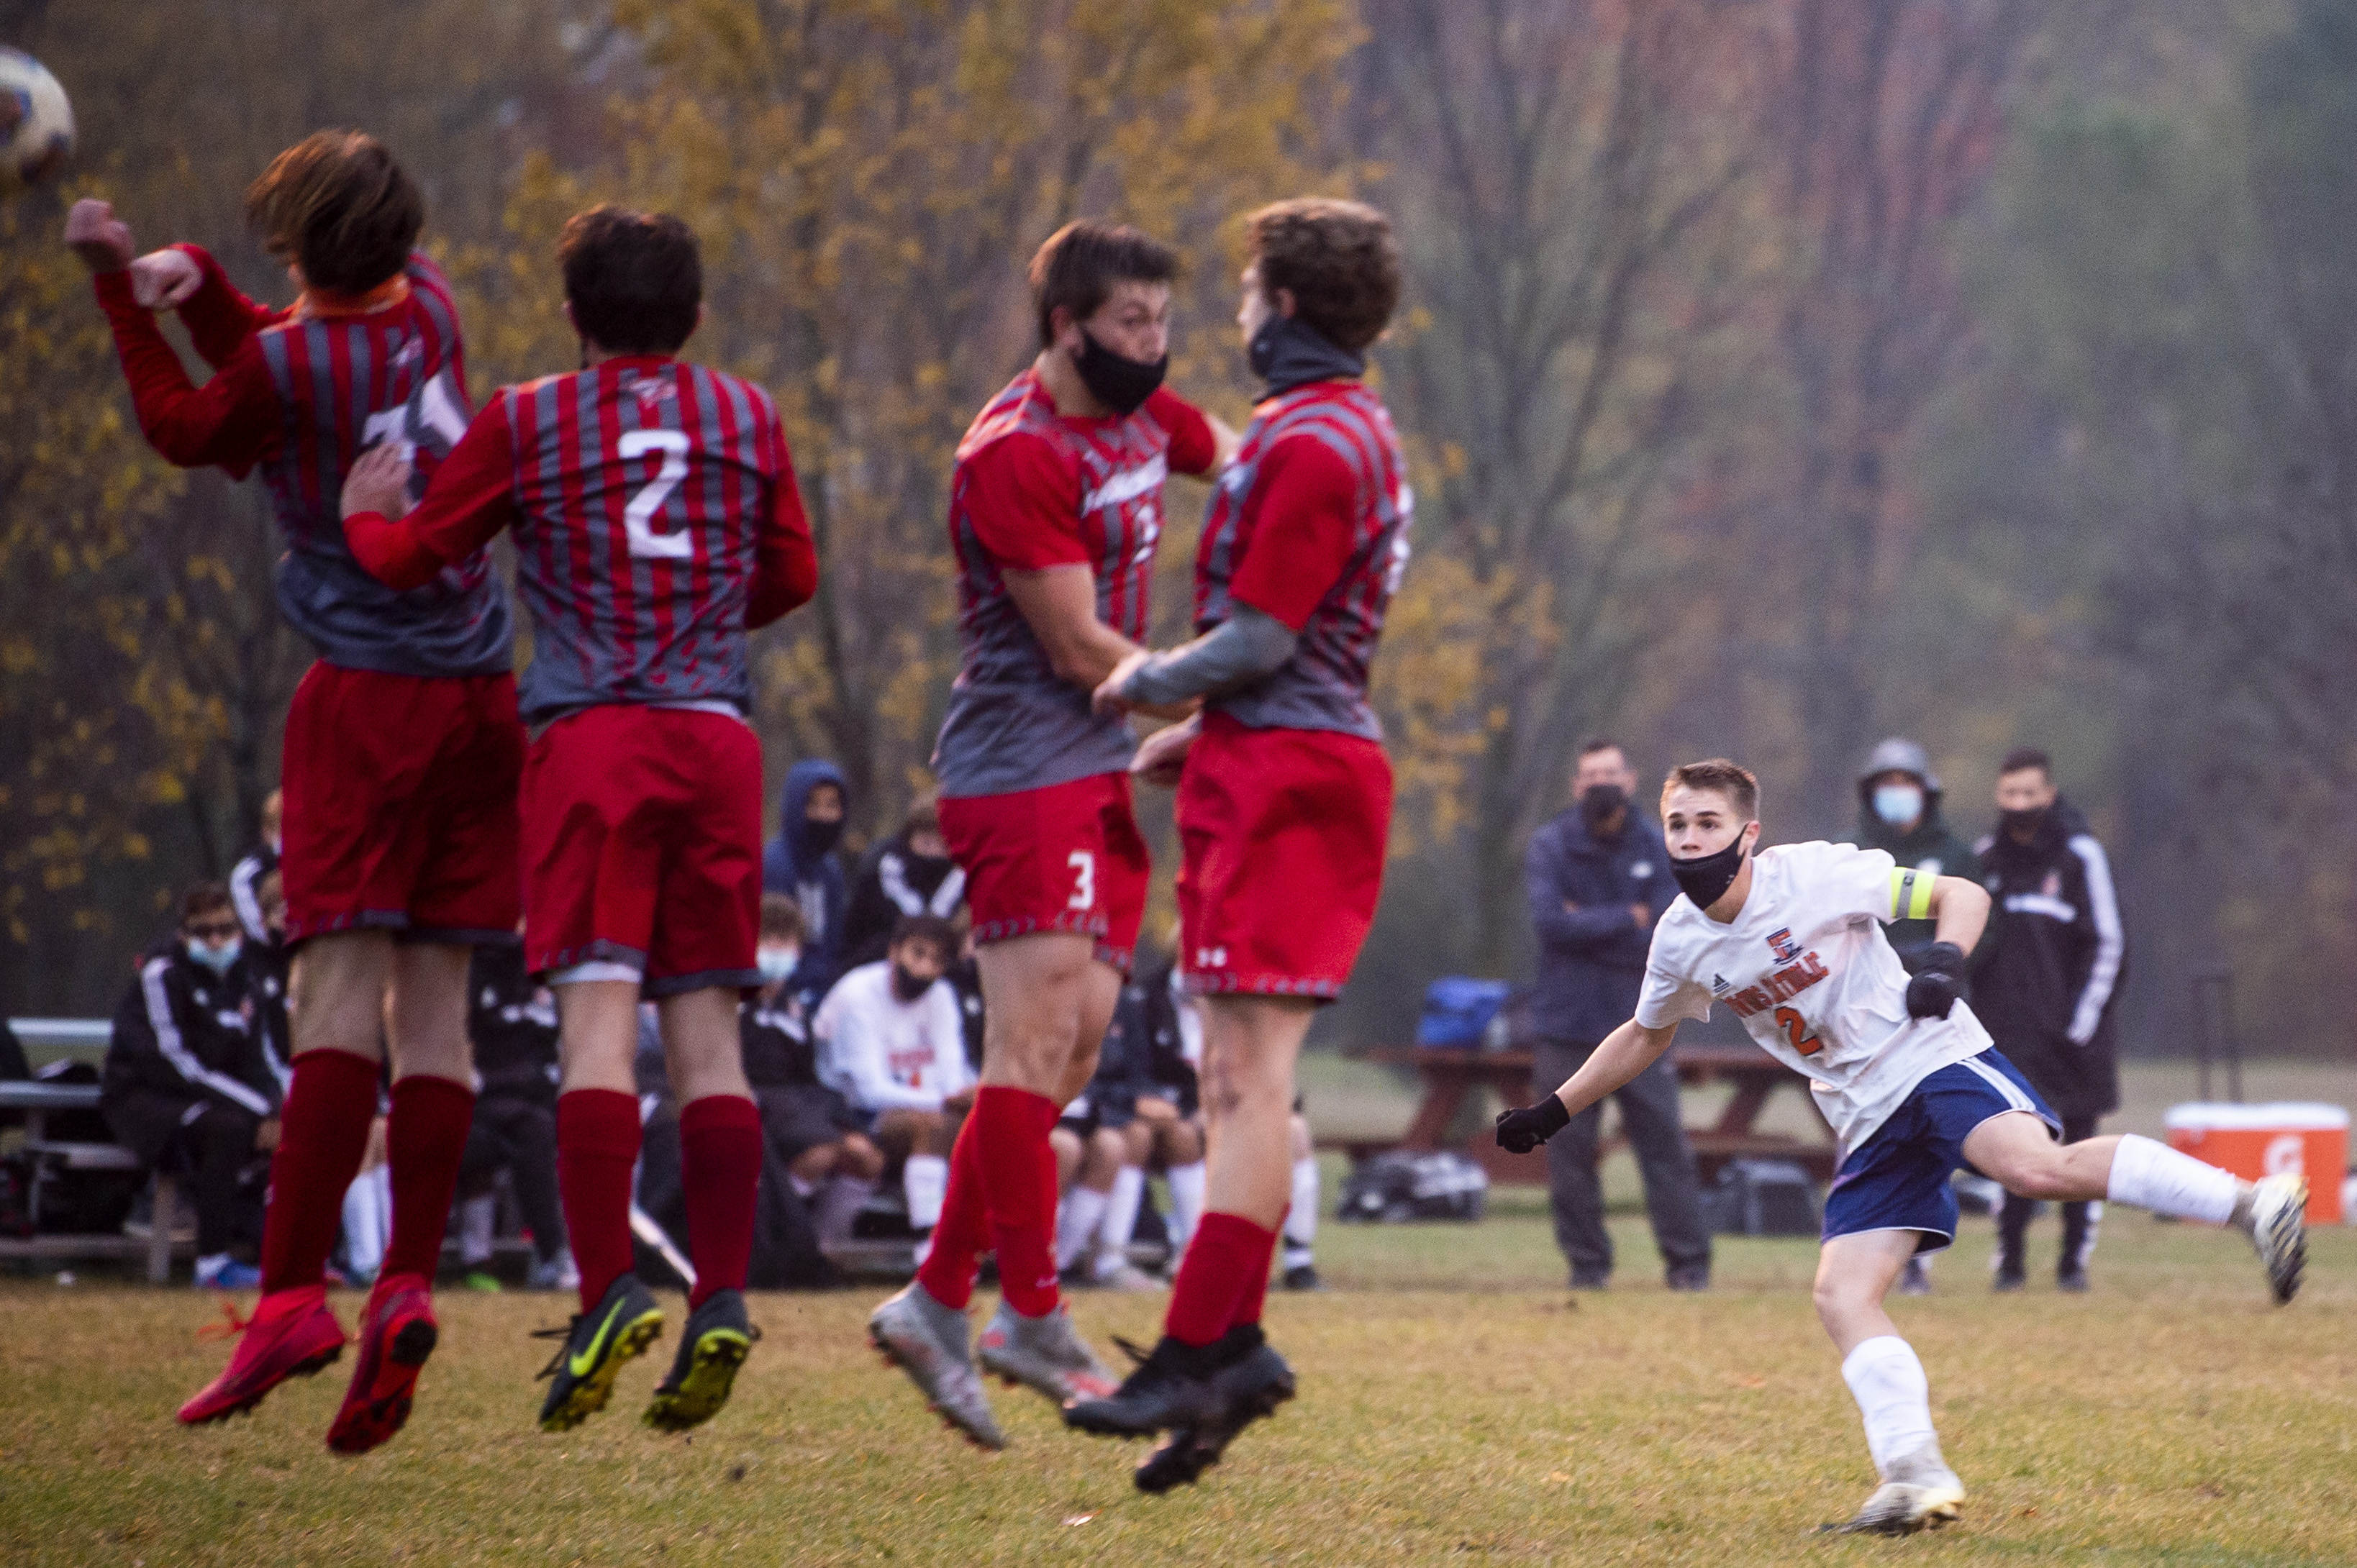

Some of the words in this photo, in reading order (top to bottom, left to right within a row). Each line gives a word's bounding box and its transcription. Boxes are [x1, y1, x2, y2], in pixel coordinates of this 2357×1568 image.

[617, 429, 695, 558] 2
[1066, 849, 1095, 910] 3
[1775, 1006, 1824, 1057] 2
